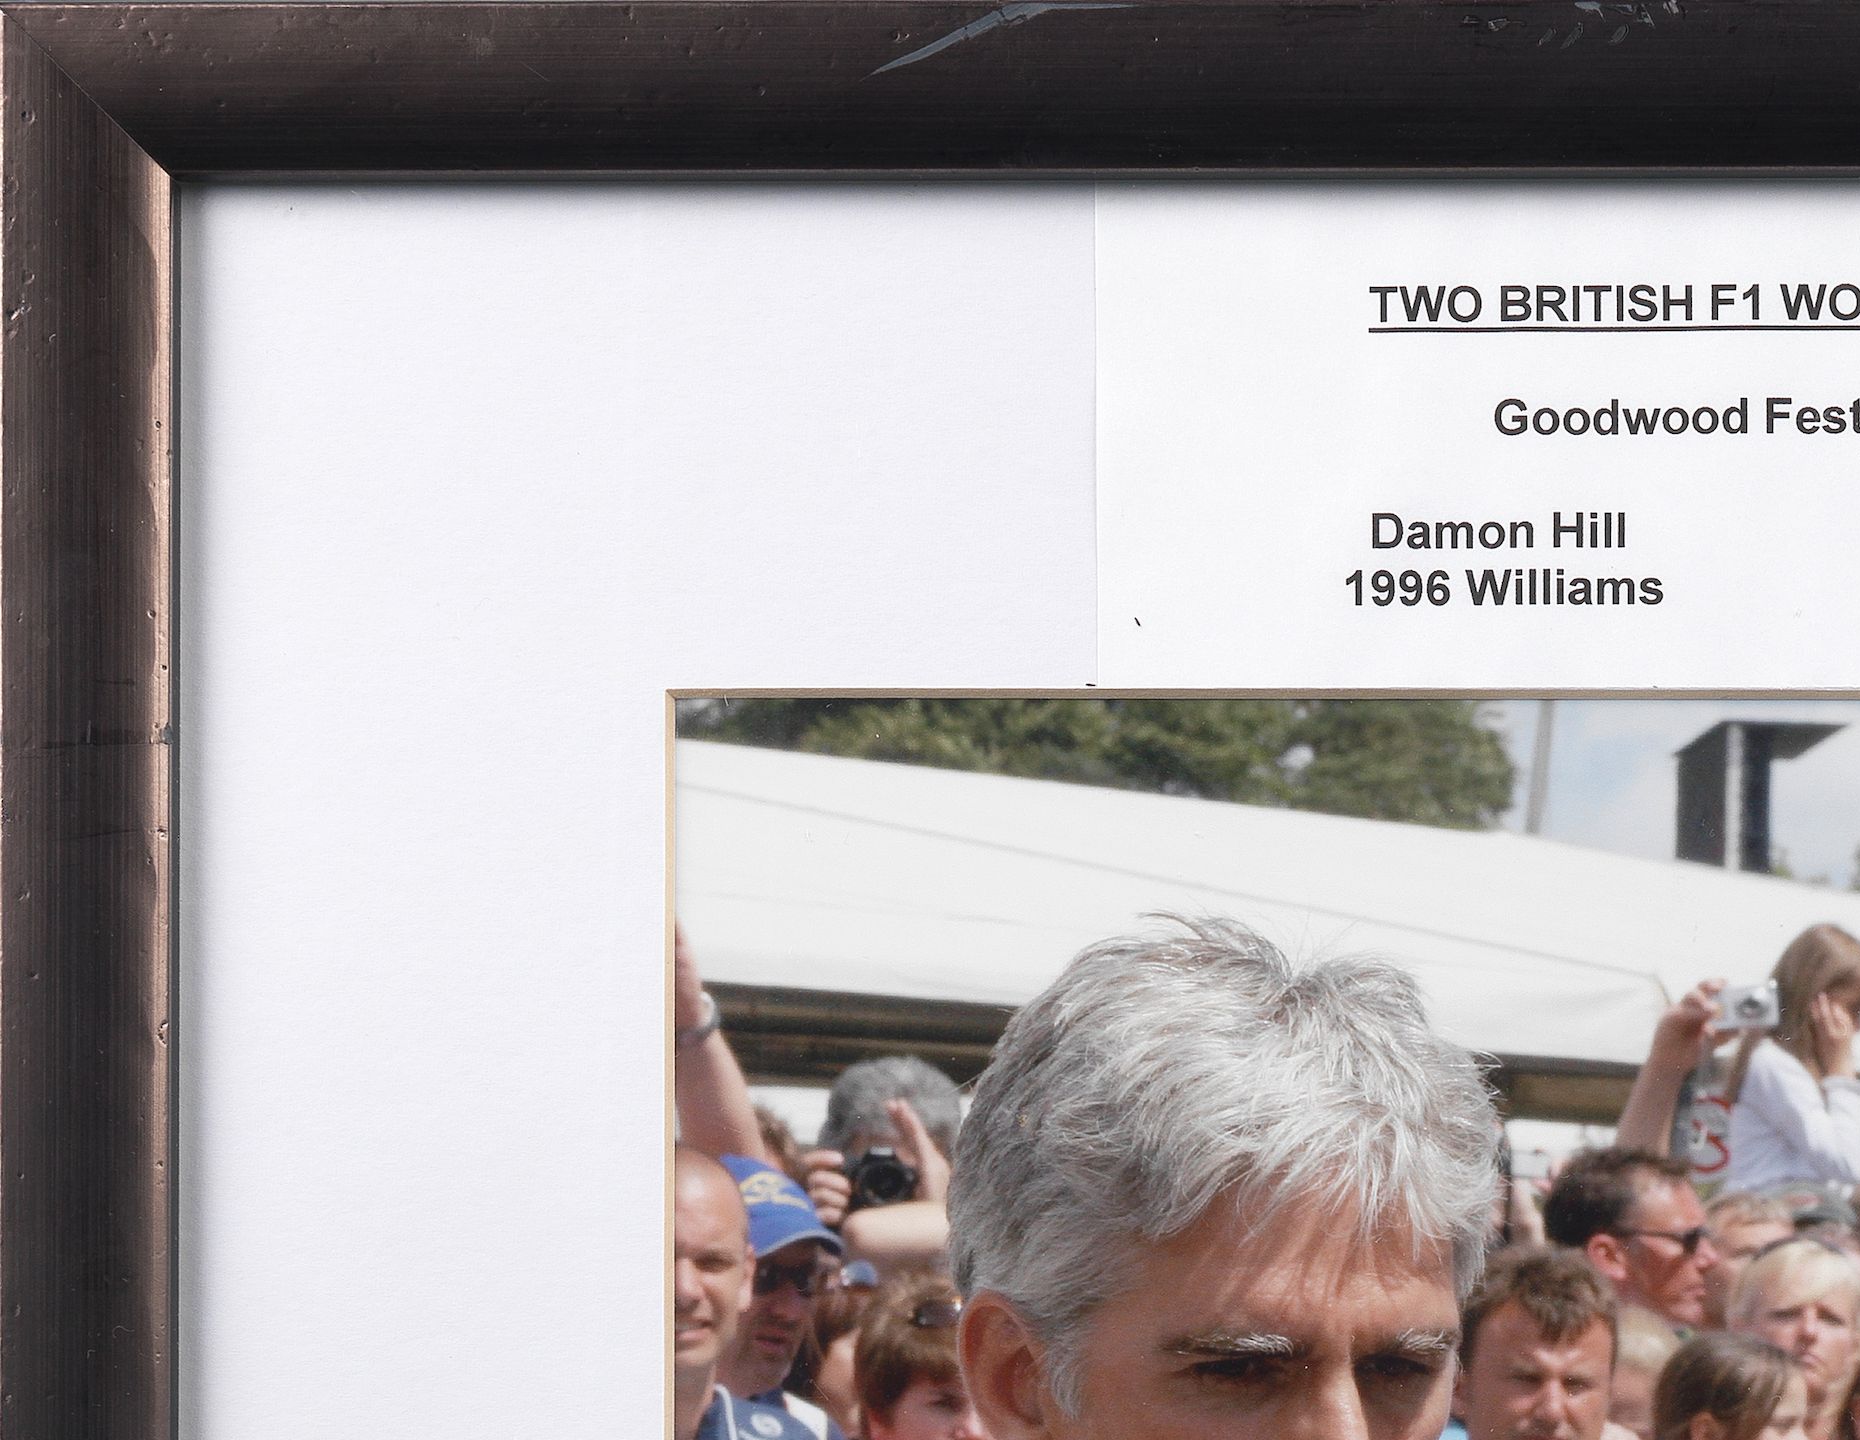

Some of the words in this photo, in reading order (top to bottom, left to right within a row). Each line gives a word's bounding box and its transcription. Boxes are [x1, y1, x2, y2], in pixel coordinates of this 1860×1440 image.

[1369, 284, 1483, 322] TWO
[1500, 283, 1693, 322] BRITISH
[1711, 283, 1760, 321] F1
[1493, 396, 1748, 436] Goodwood
[1371, 511, 1534, 550] Damon
[1553, 511, 1626, 549] Hill
[1345, 568, 1451, 607] 1996
[1464, 567, 1664, 606] Williams
